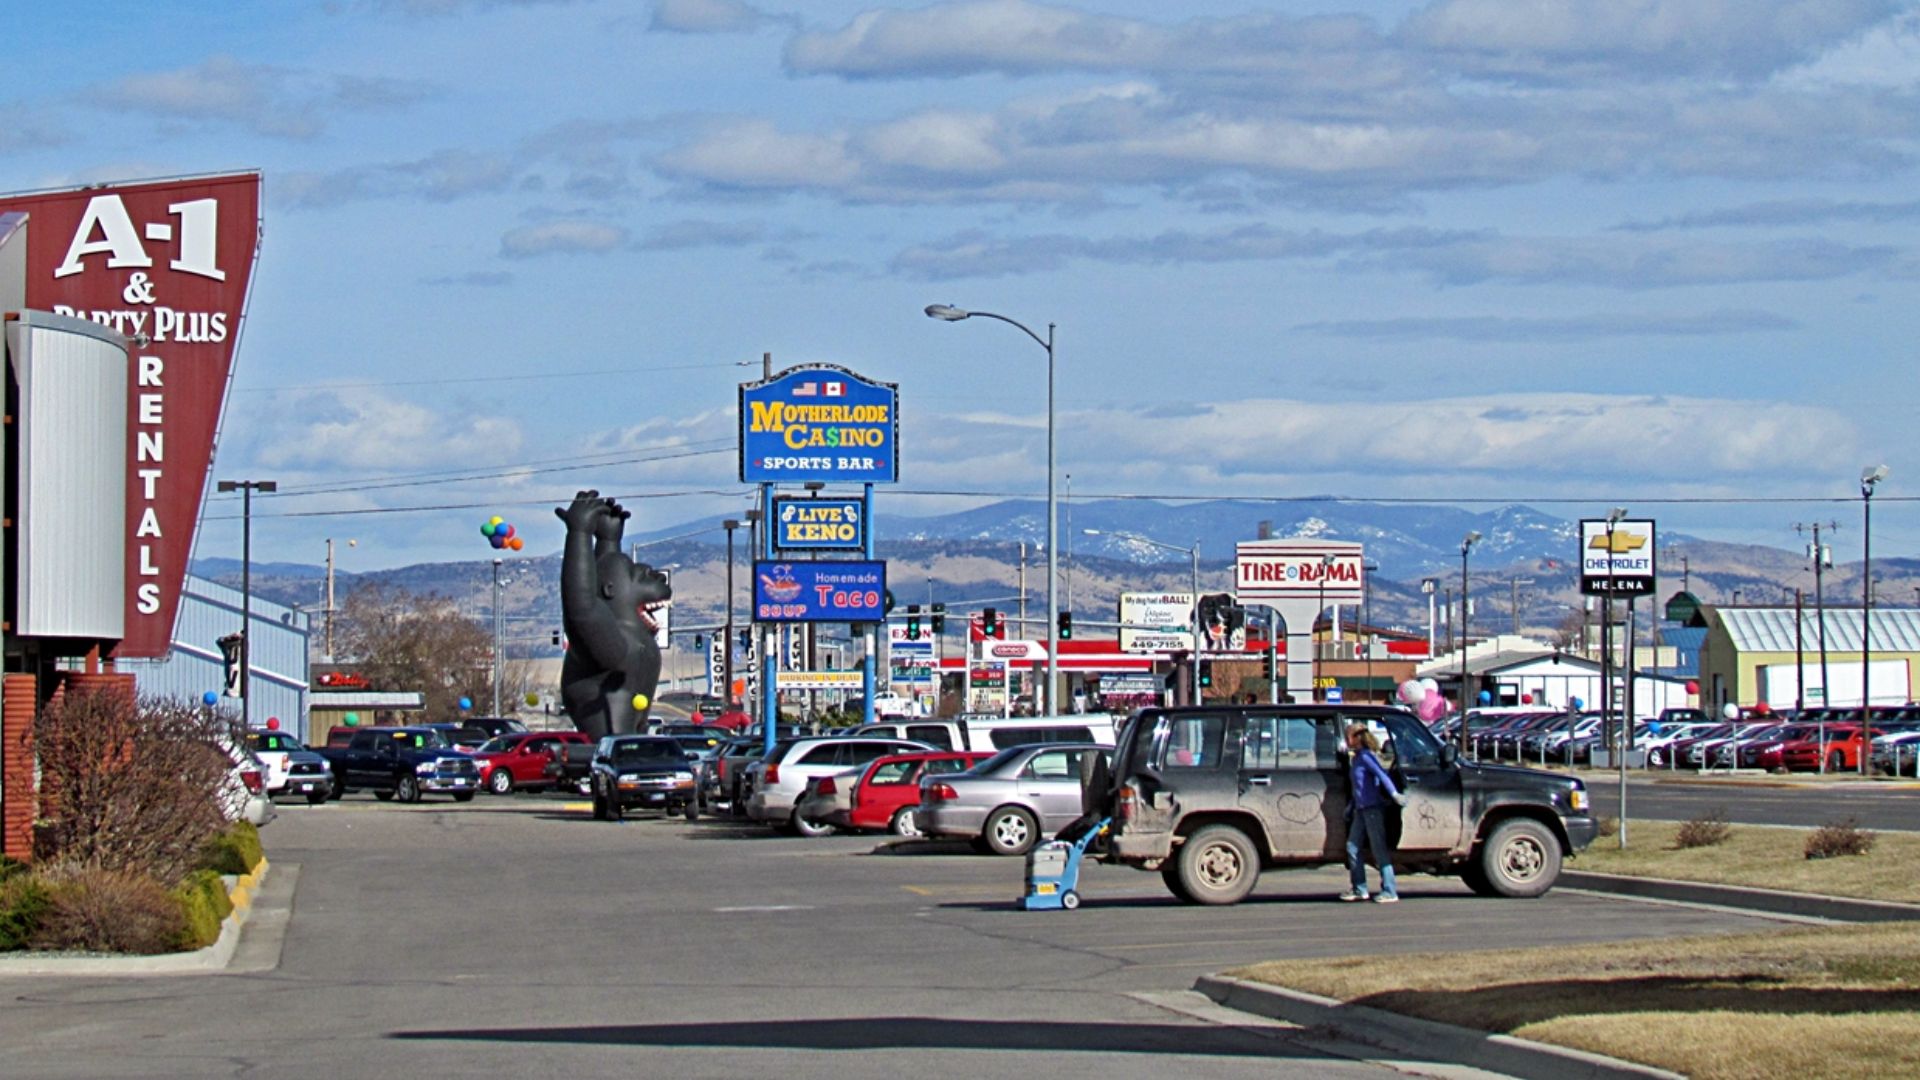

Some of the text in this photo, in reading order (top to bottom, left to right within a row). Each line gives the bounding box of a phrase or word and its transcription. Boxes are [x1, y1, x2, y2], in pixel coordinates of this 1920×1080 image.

[54, 194, 226, 282] A-1
[123, 271, 156, 304] &
[53, 305, 148, 336] RTY
[750, 401, 888, 432] MOTHERLODE
[763, 457, 875, 470] SPORTS BAR
[136, 356, 164, 614] RENTALS
[798, 508, 842, 521] LIVE
[787, 524, 855, 541] KENO
[815, 572, 878, 583] Homemade
[1241, 562, 1286, 582] TIRE
[1299, 562, 1359, 582] RAMA
[814, 585, 879, 608] Taco
[759, 604, 807, 617] SOUP
[892, 628, 932, 639] EXN
[713, 630, 724, 693] ELCOME
